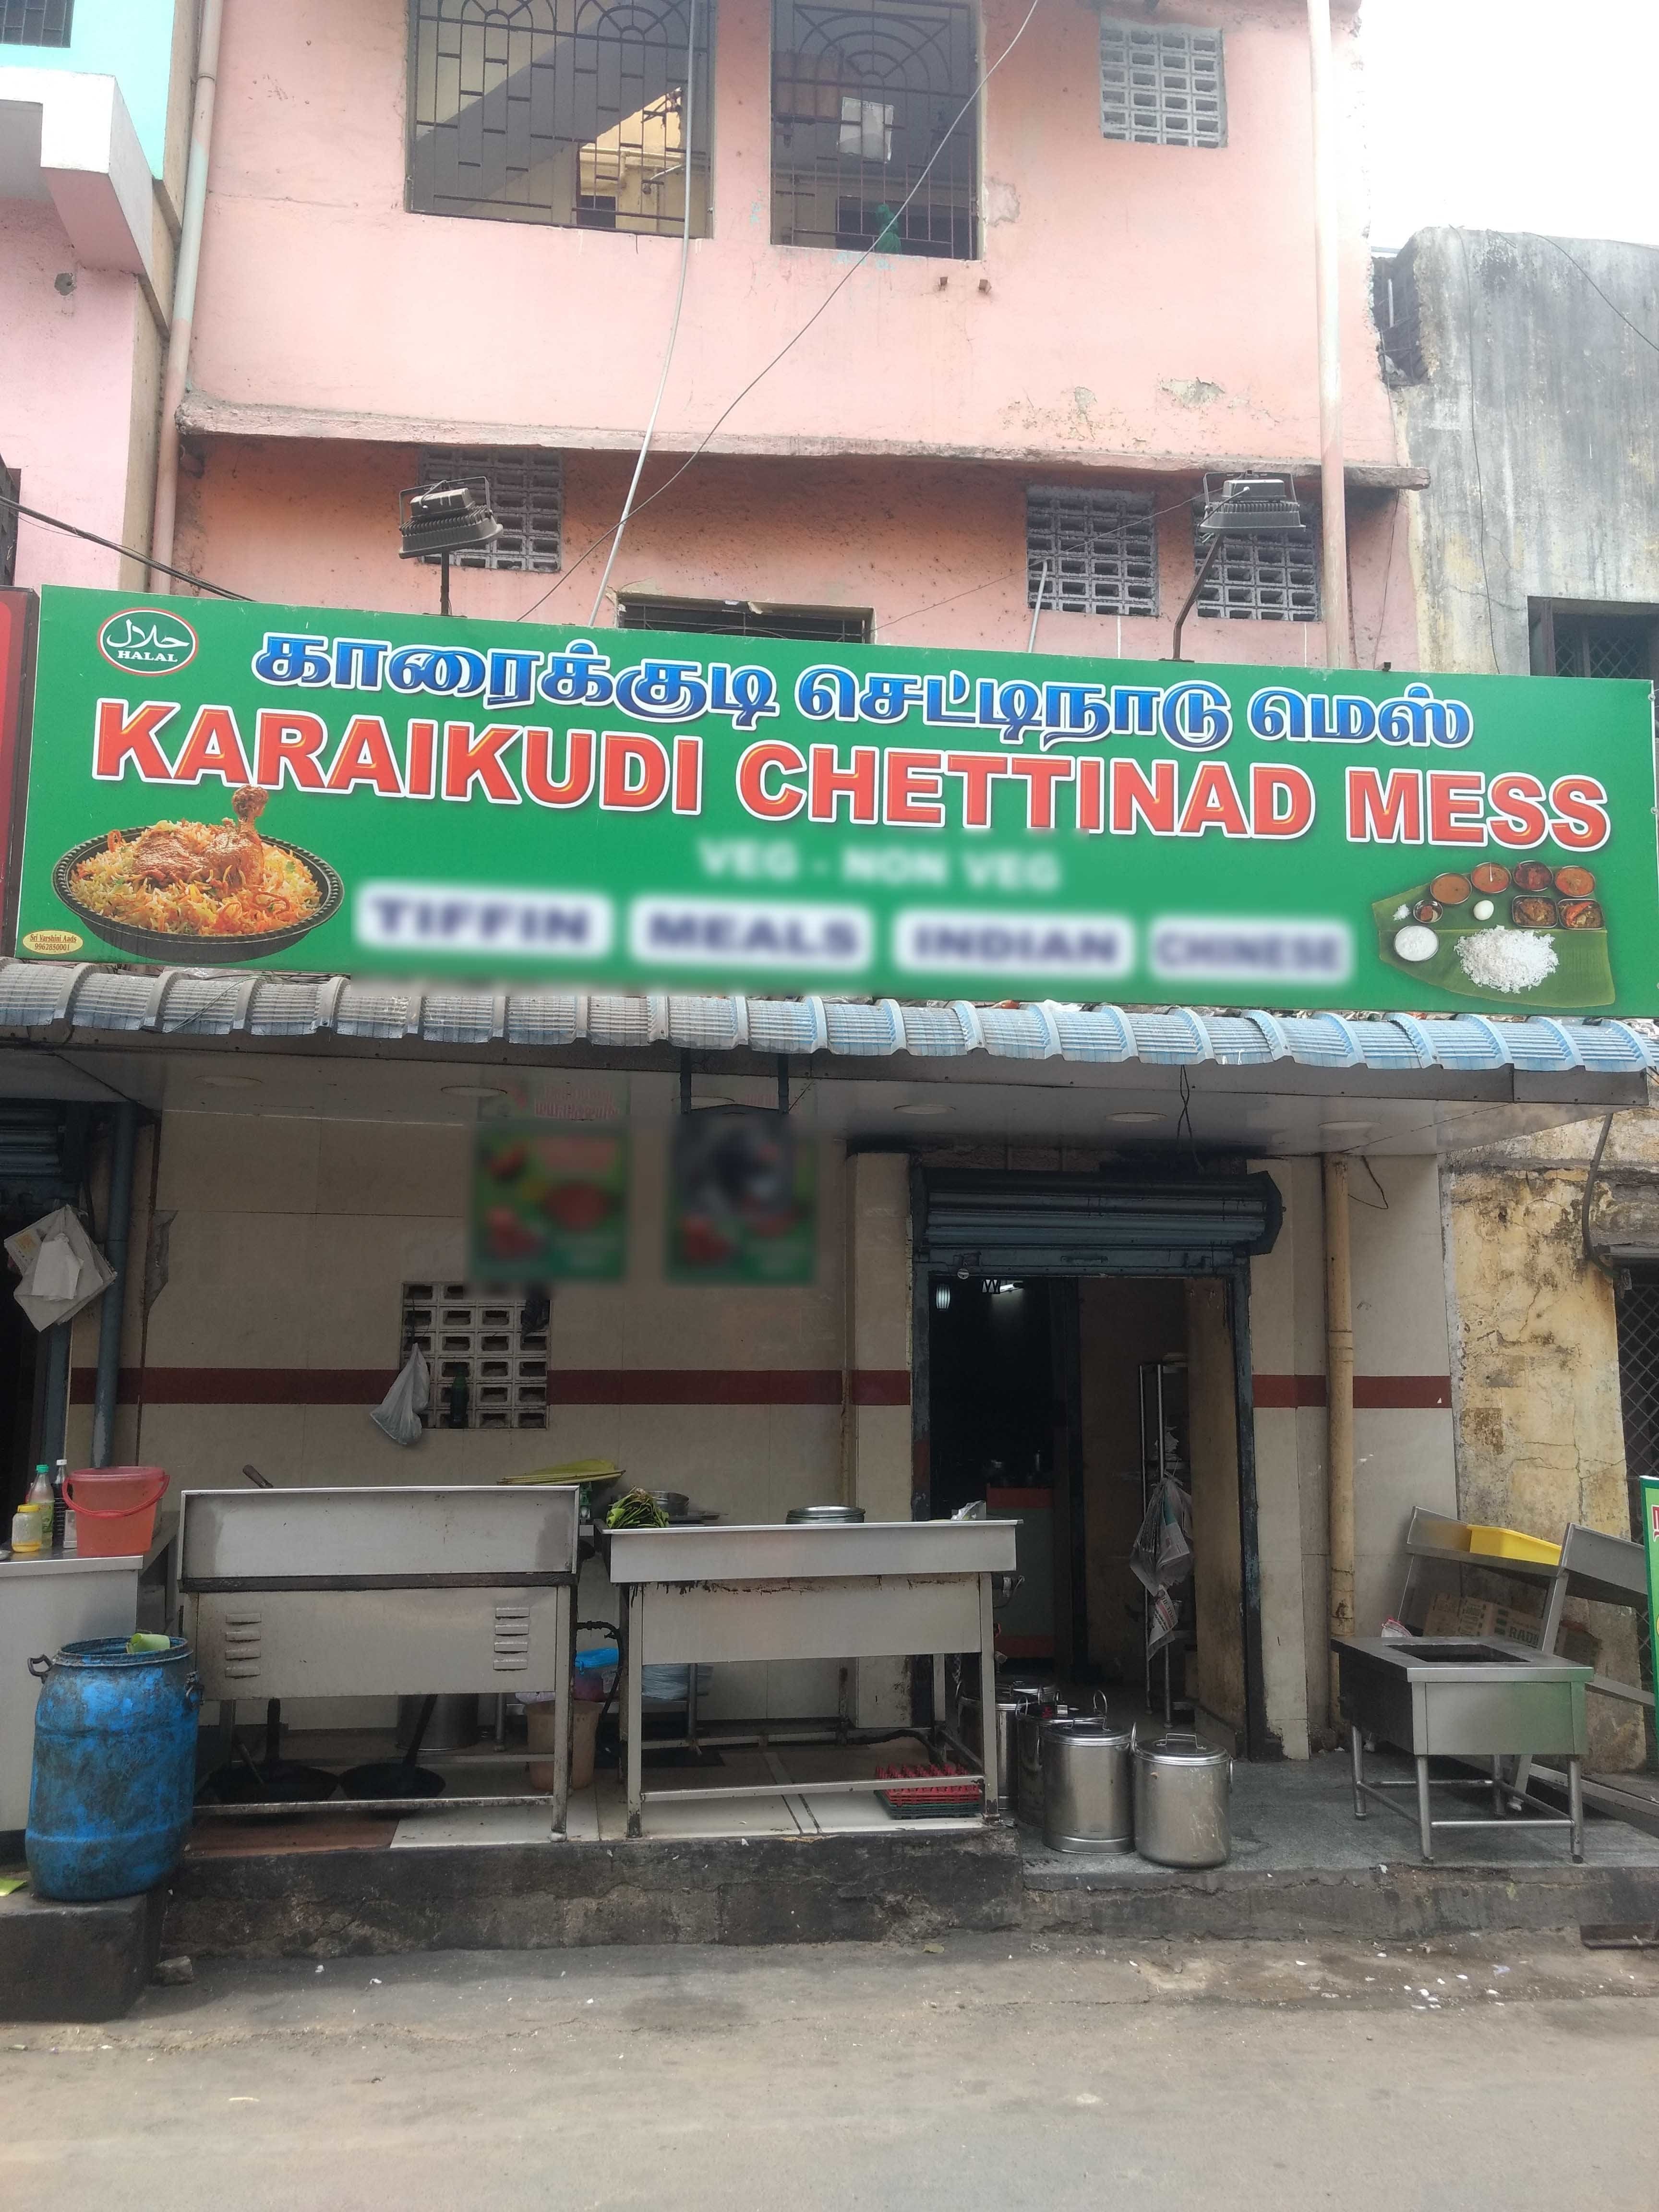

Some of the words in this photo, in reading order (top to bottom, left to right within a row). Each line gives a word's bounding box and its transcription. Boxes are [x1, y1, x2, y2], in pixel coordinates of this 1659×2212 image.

[107, 618, 190, 649] حلال
[117, 649, 178, 662] HALAL
[253, 635, 777, 726] காரைக்குடி
[796, 665, 1230, 747] செட்டிநாடு
[1249, 684, 1472, 745] மெஸ்
[95, 700, 700, 812] KARAIKUDI
[738, 742, 1312, 836] CHETTINAD
[1348, 769, 1608, 849] MESS
[40, 934, 61, 942] Varshini
